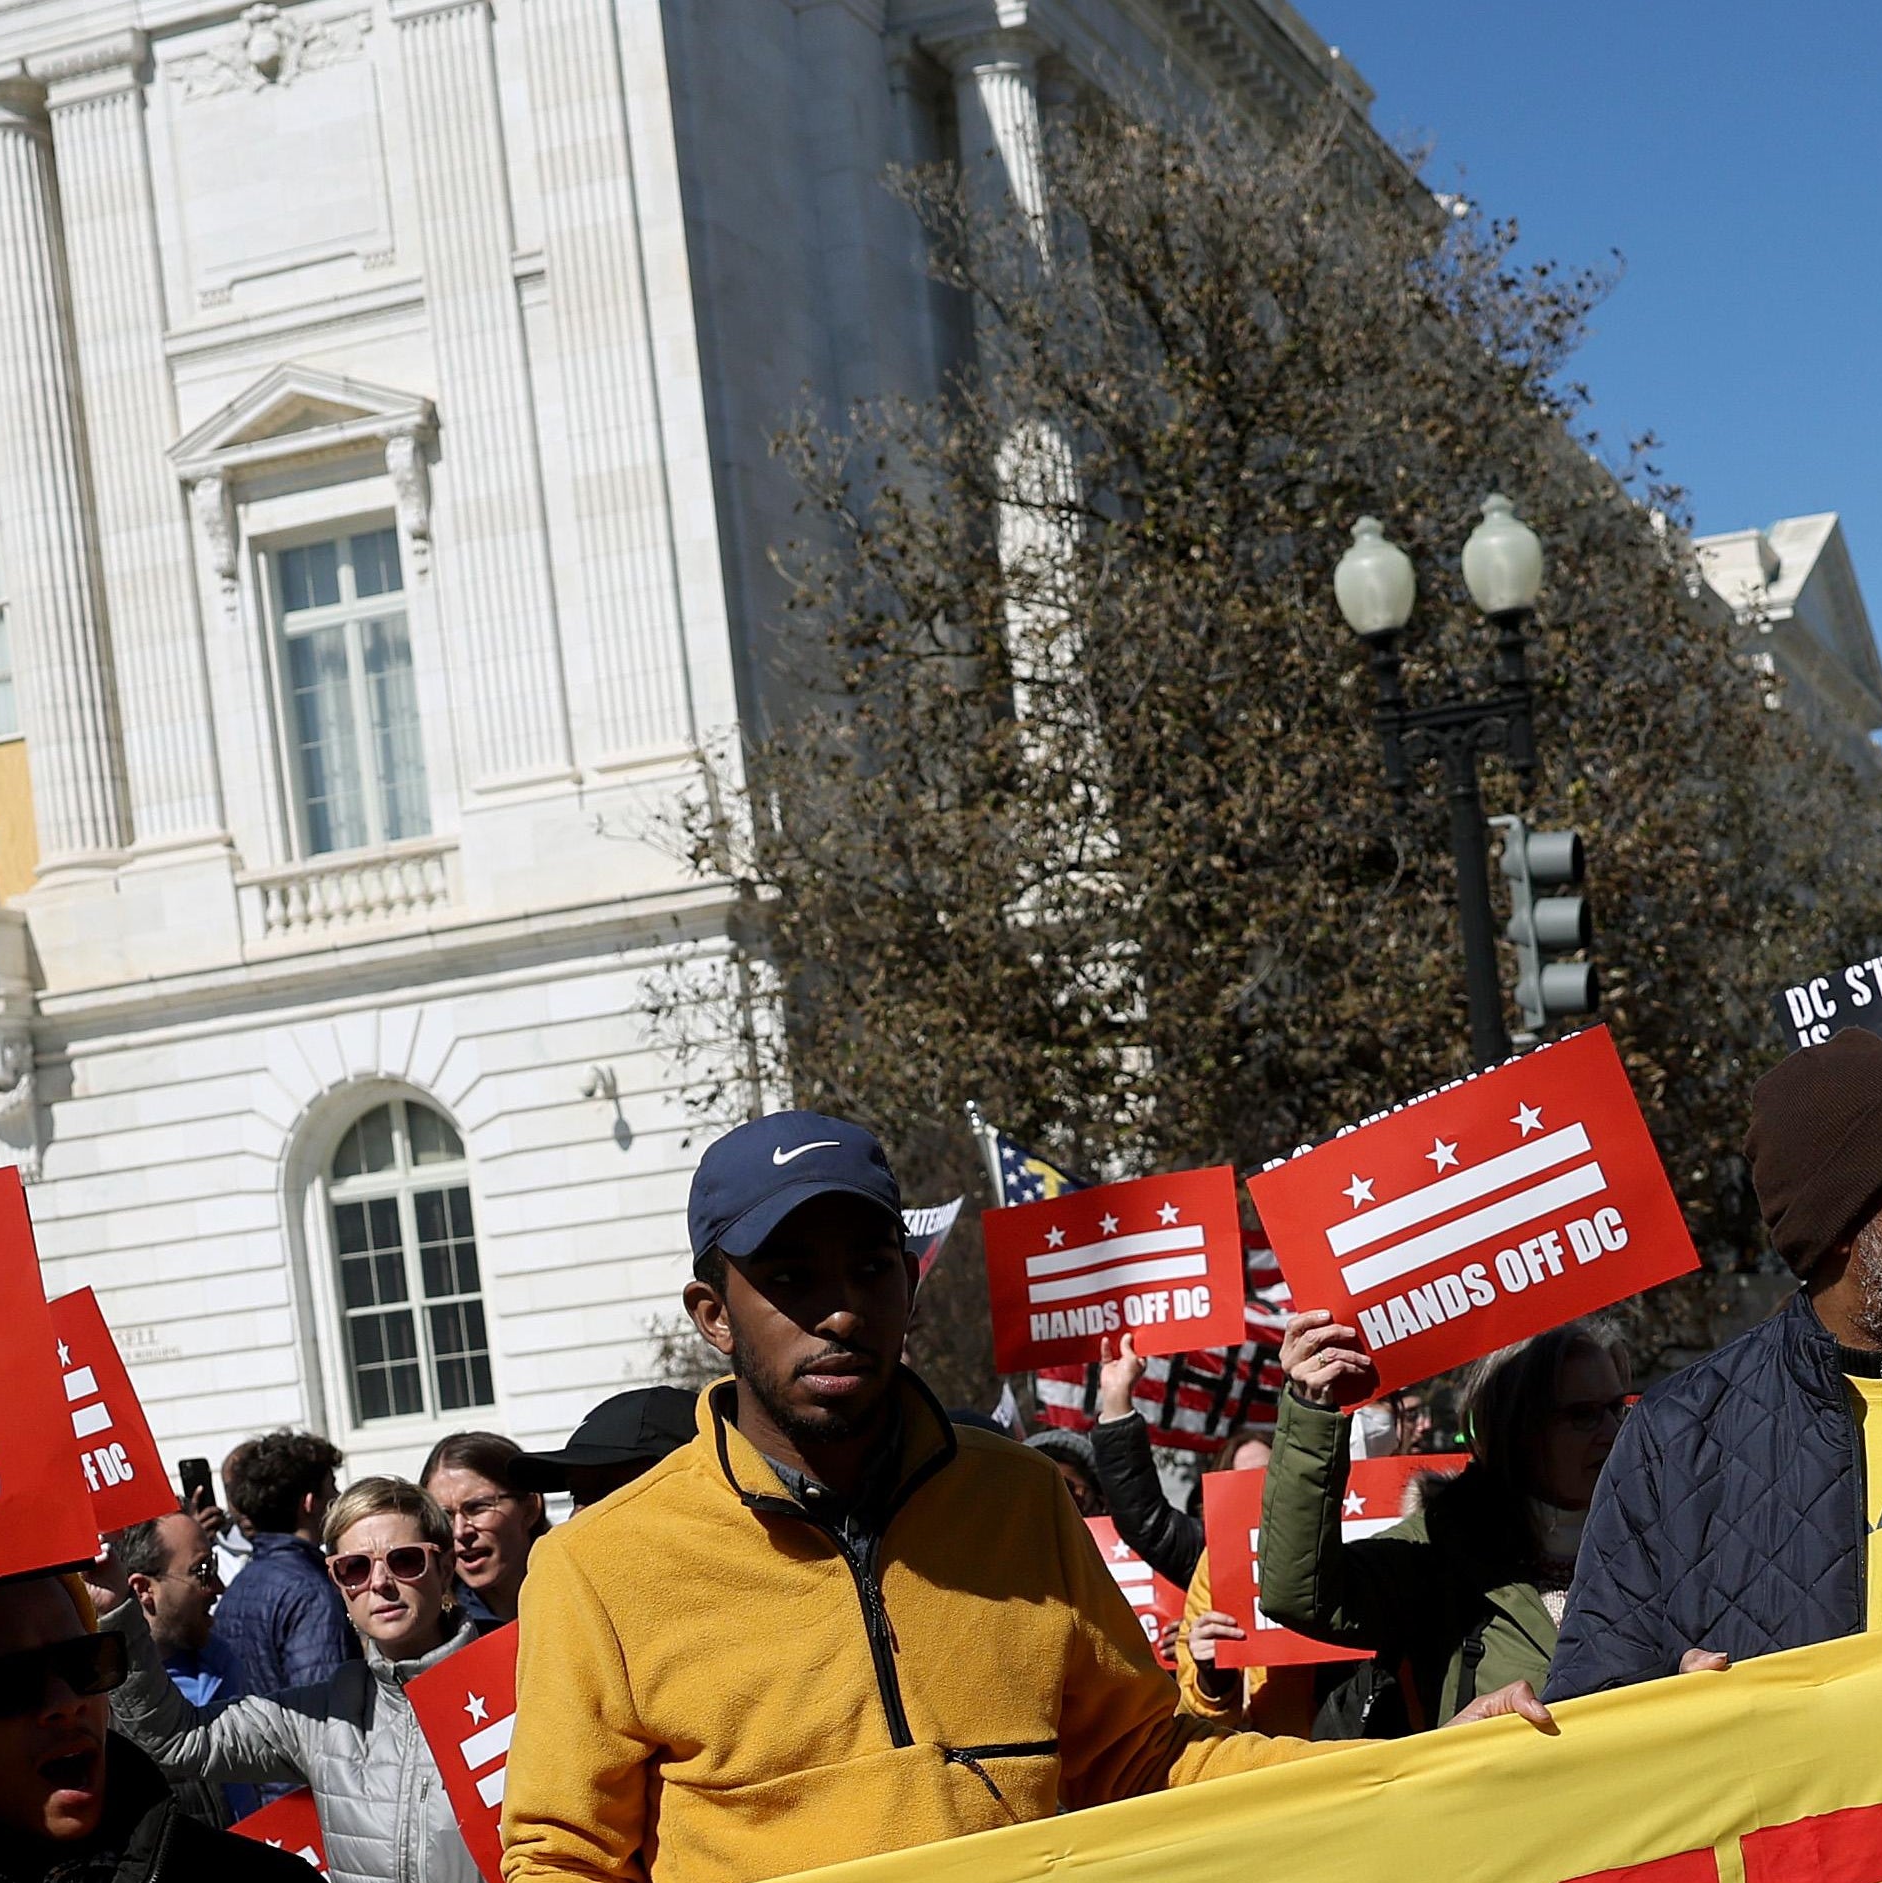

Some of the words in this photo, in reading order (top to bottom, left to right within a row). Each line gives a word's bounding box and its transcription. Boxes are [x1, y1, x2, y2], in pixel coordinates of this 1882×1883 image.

[1785, 977, 1837, 1028] DC
[1357, 1263, 1496, 1350] HANDS
[1495, 1230, 1565, 1293] OFF
[1565, 1206, 1628, 1265] DC
[1030, 1300, 1120, 1342] HANDS
[1123, 1291, 1170, 1327] OFF
[1172, 1285, 1211, 1321] DC
[93, 1442, 134, 1487] DC
